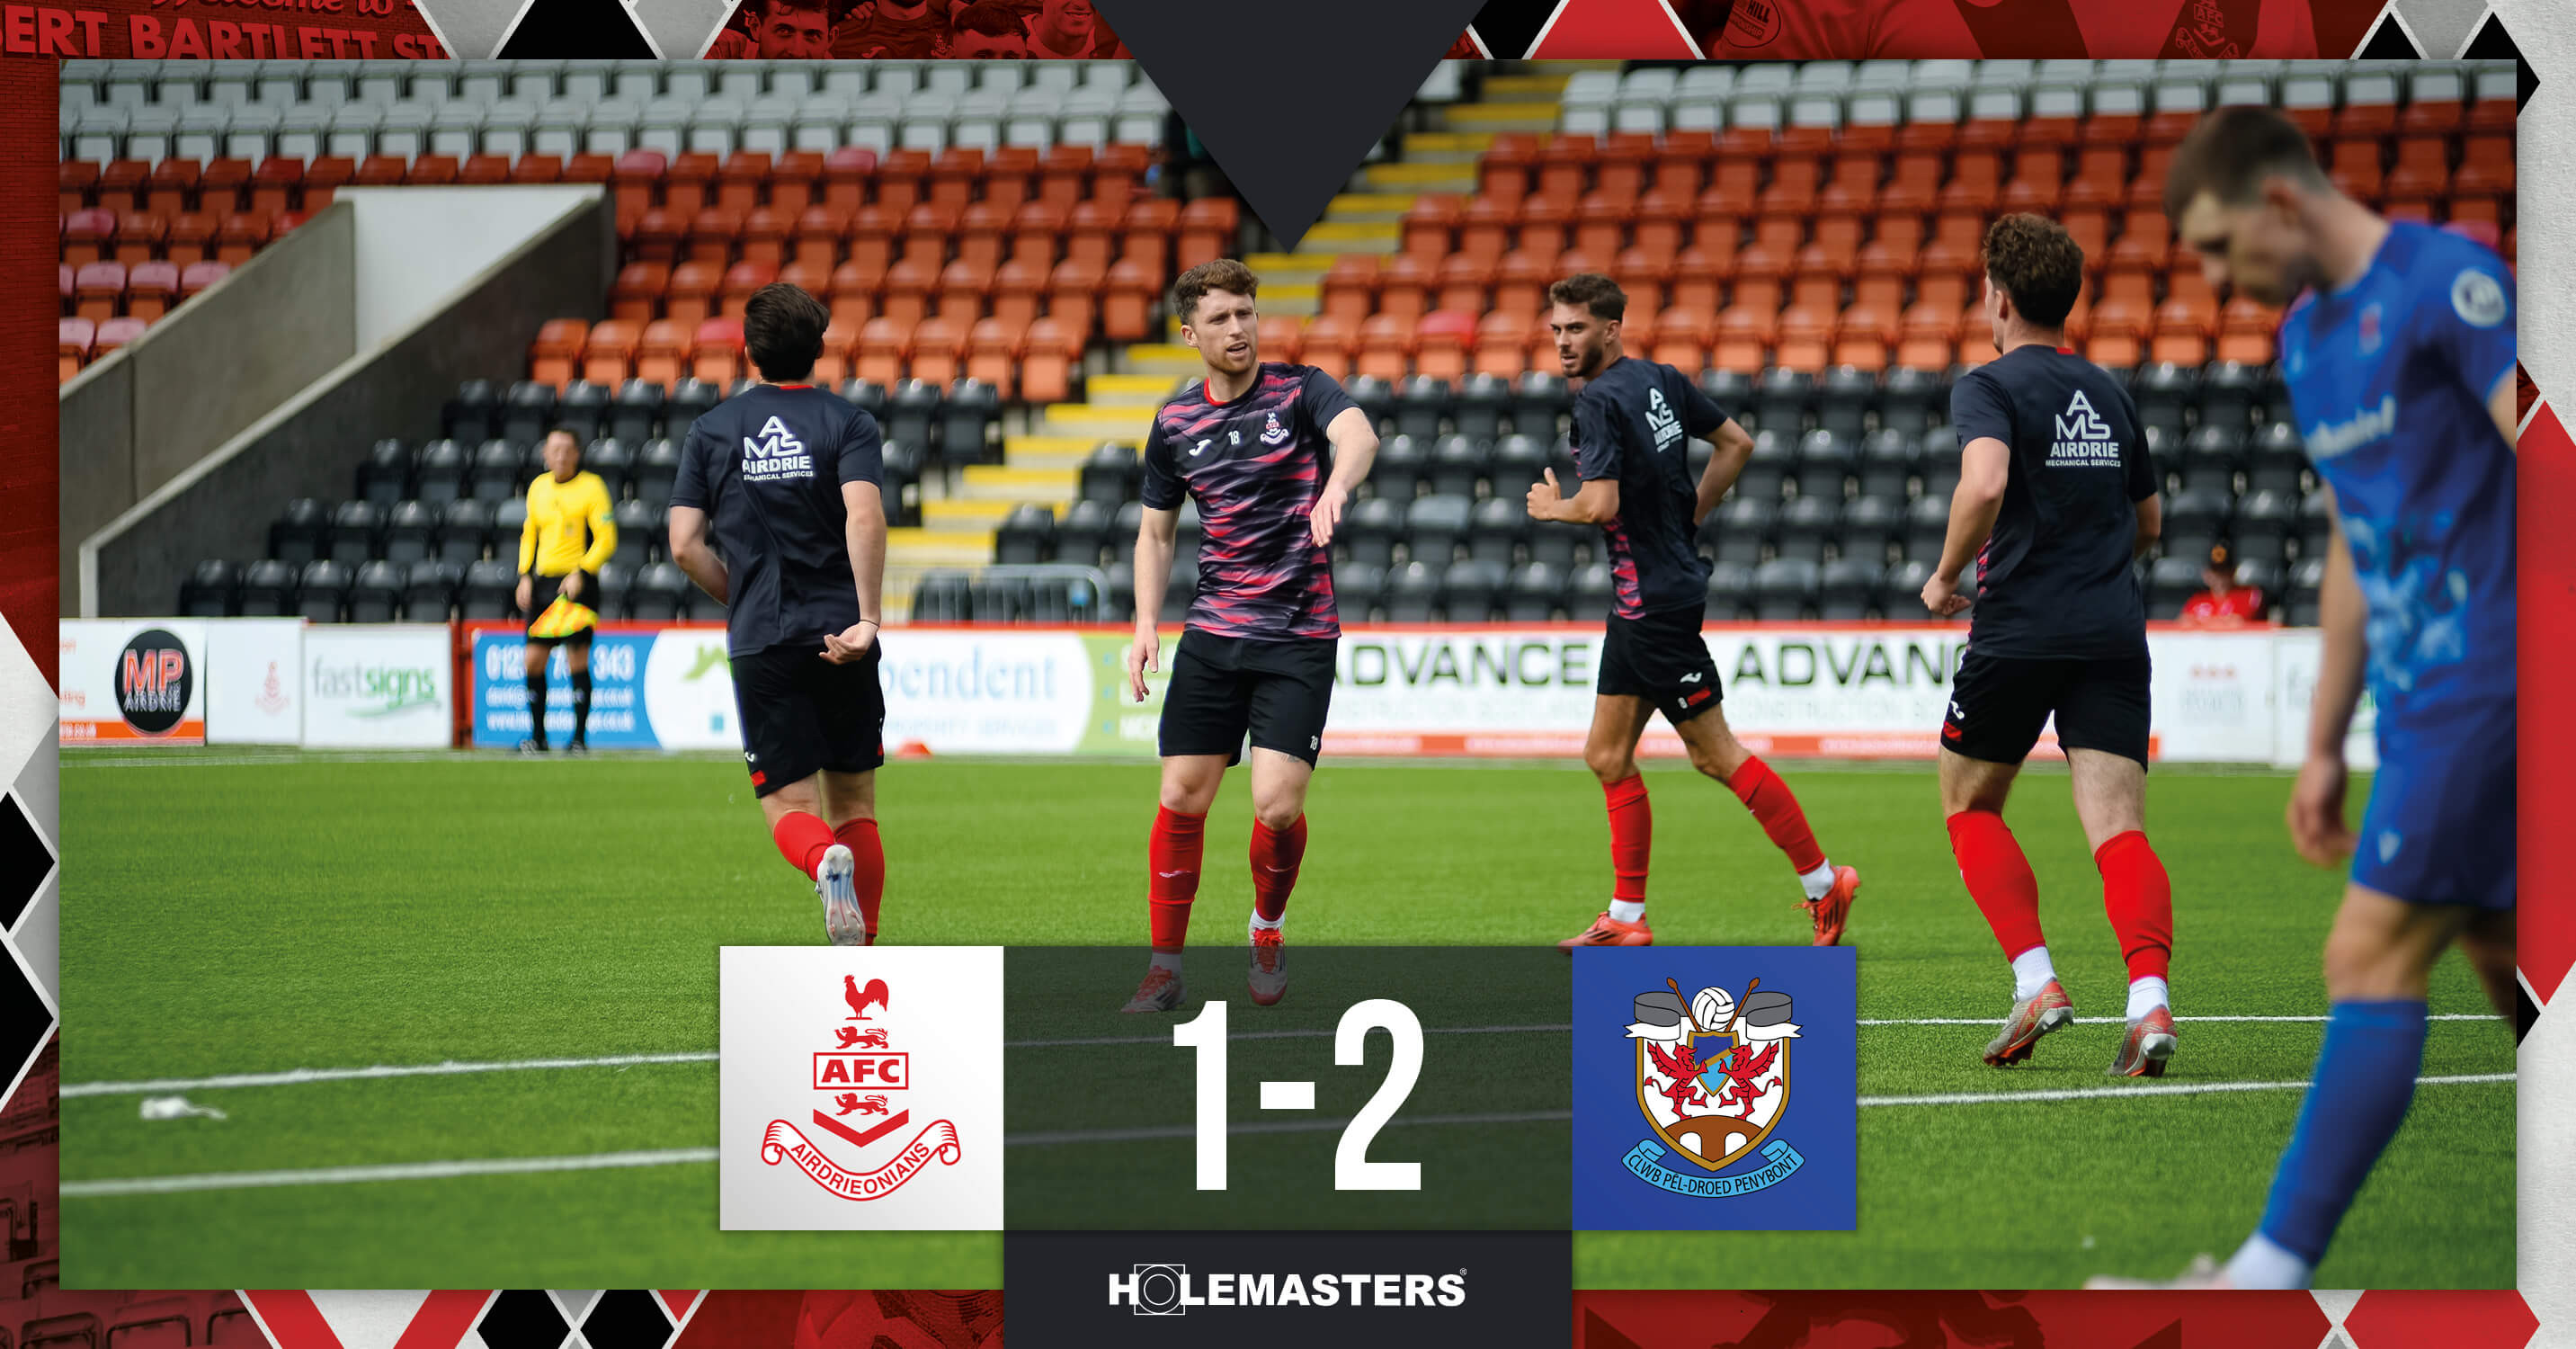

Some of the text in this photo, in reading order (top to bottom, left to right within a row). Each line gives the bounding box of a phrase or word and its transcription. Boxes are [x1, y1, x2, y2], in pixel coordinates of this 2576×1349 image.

[0, 4, 108, 56] ERT
[130, 13, 379, 59] BARTLETT
[1228, 430, 1241, 445] 18
[2050, 442, 2119, 457] AIRDRIE
[742, 456, 811, 474] AIRDRIE
[2046, 460, 2121, 468] MECHANICAL SERVICES
[123, 649, 184, 693] MP
[314, 655, 435, 705] fastsigns
